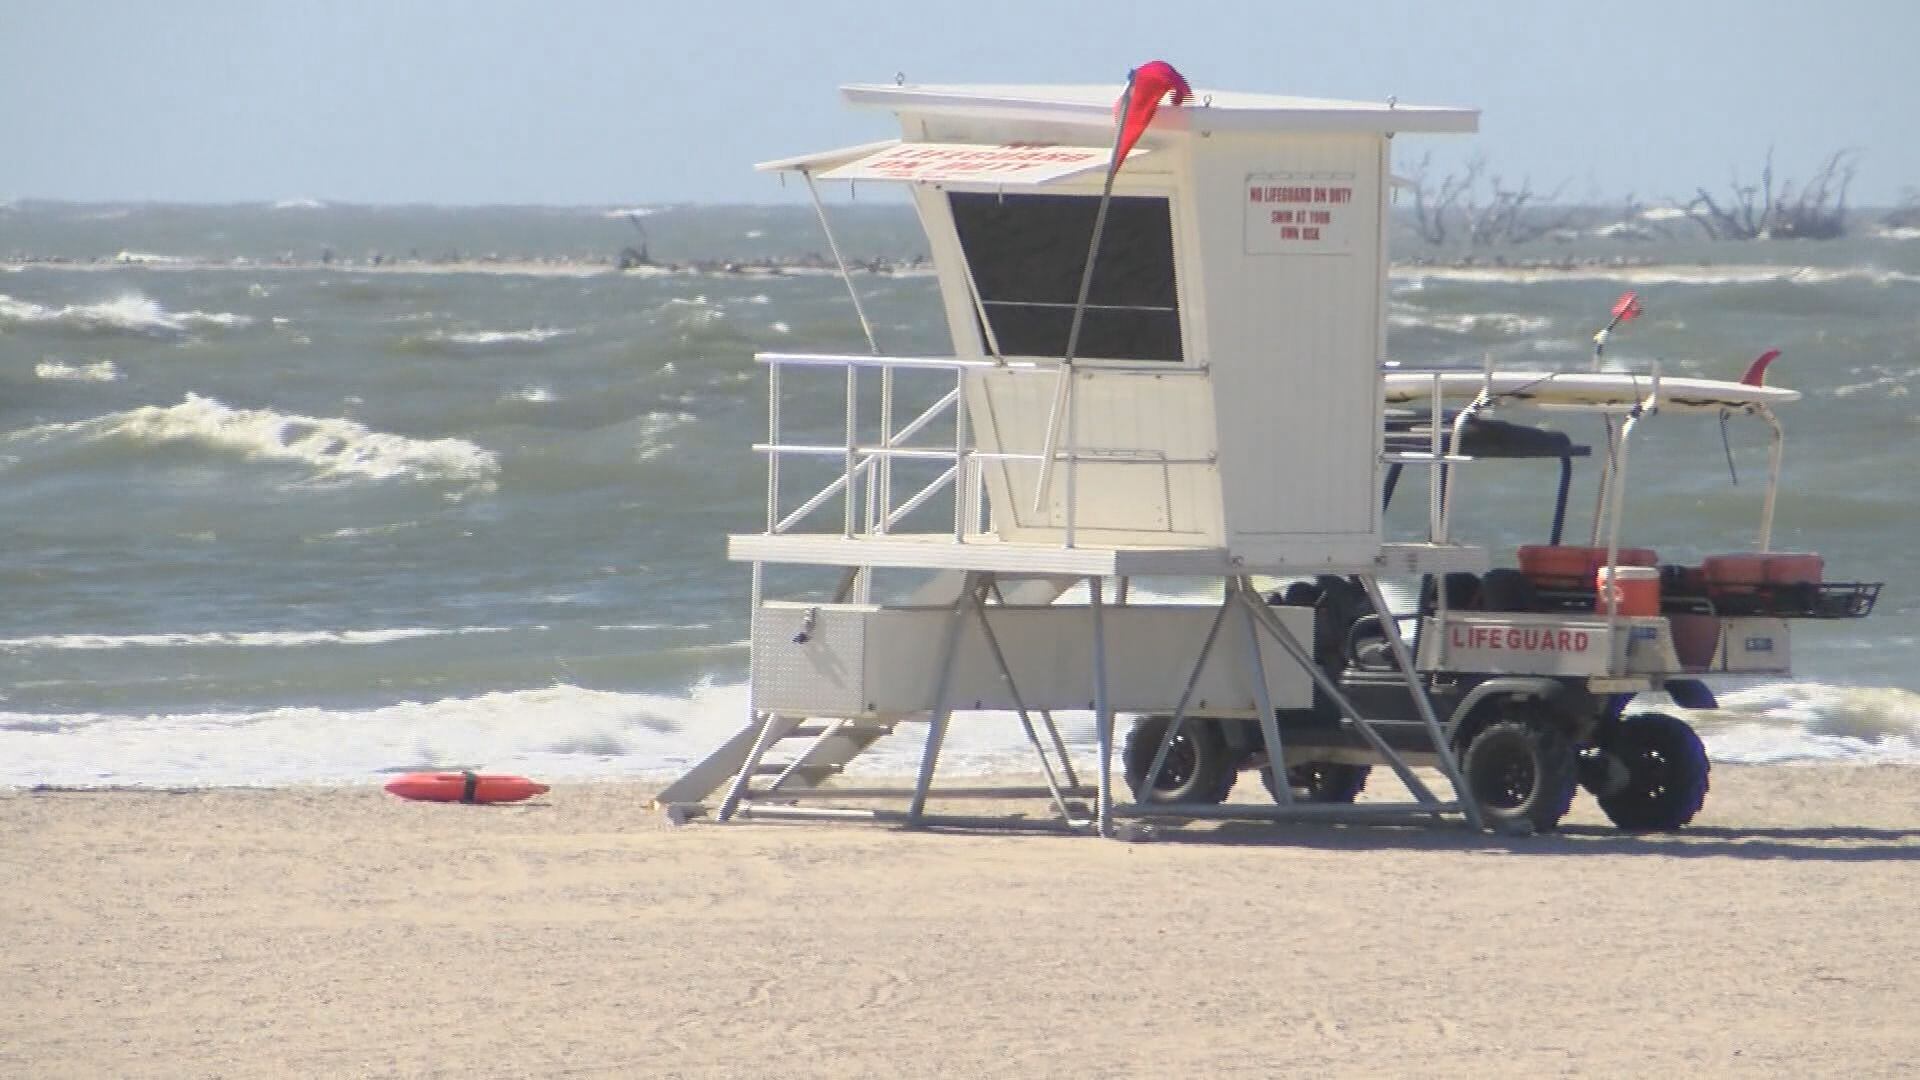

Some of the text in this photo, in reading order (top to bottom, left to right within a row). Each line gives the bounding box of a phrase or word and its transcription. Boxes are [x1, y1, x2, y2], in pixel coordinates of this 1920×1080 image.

[1250, 186, 1352, 203] NO LIFEGUARD ON DUTY
[1271, 210, 1293, 223] SWIM
[1296, 210, 1306, 223] AT
[1453, 627, 1590, 652] LIFEGUARD
